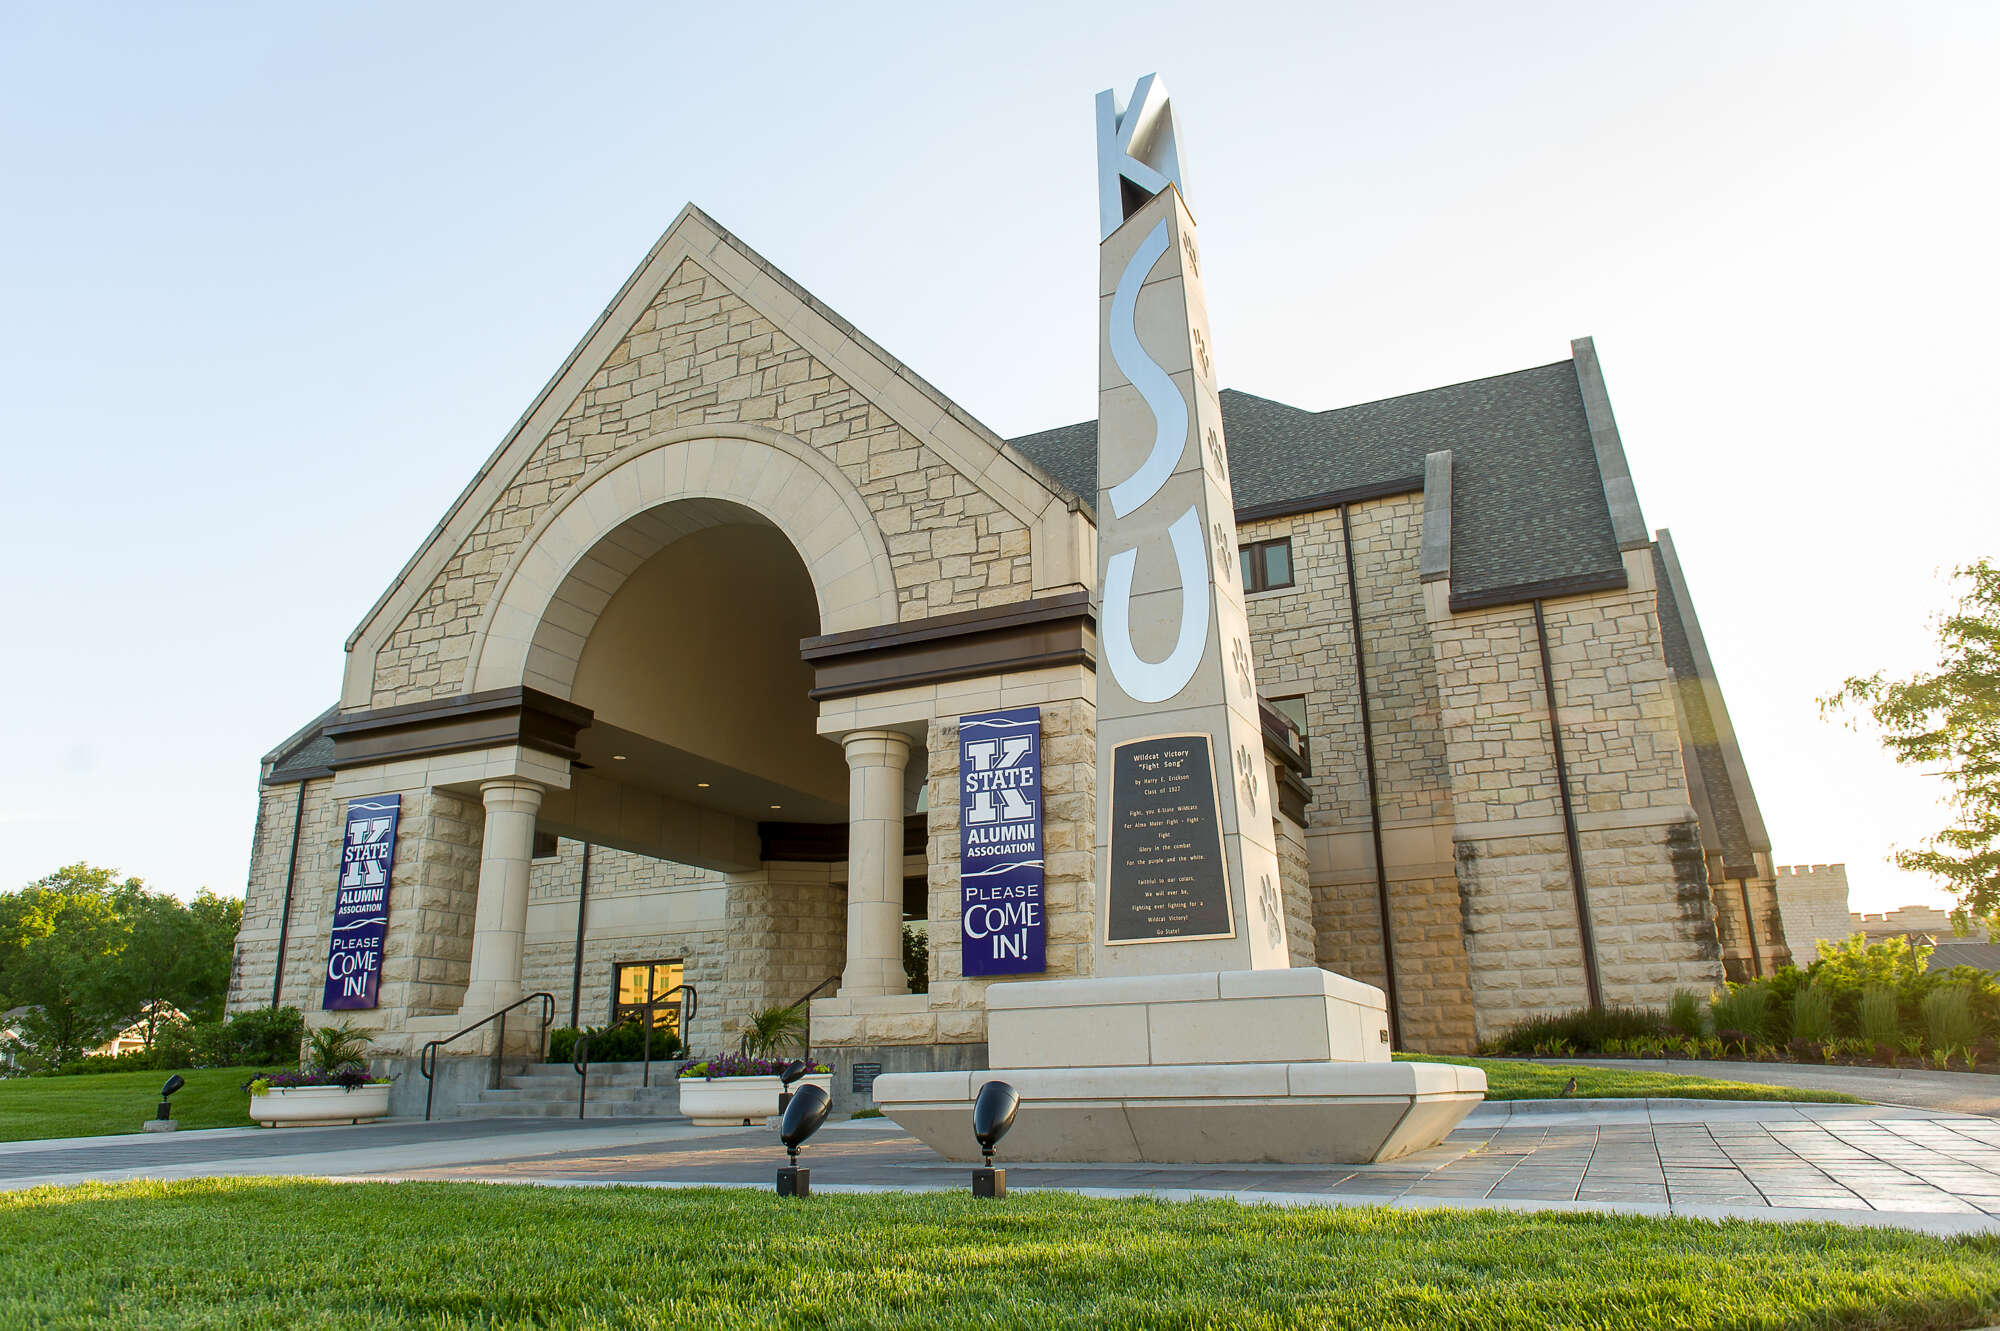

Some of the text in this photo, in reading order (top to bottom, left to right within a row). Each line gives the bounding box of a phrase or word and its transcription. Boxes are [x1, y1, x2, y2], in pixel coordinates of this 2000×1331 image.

[1133, 750, 1189, 762] Wildcat Victory
[1138, 759, 1184, 771] "Fight Song"
[965, 766, 1034, 793] STATE
[967, 823, 1035, 845] ALUMNI
[344, 842, 389, 863] STATE
[967, 842, 1035, 858] ASSOCIATION
[340, 888, 384, 905] ALUMNI
[966, 884, 1039, 902] PLEASE
[338, 902, 382, 916] ASSOCIATION
[964, 901, 1041, 939] COME
[332, 937, 380, 951] PLEASE
[992, 927, 1029, 961] IN!
[329, 950, 378, 981] COME
[343, 971, 368, 998] IN!
